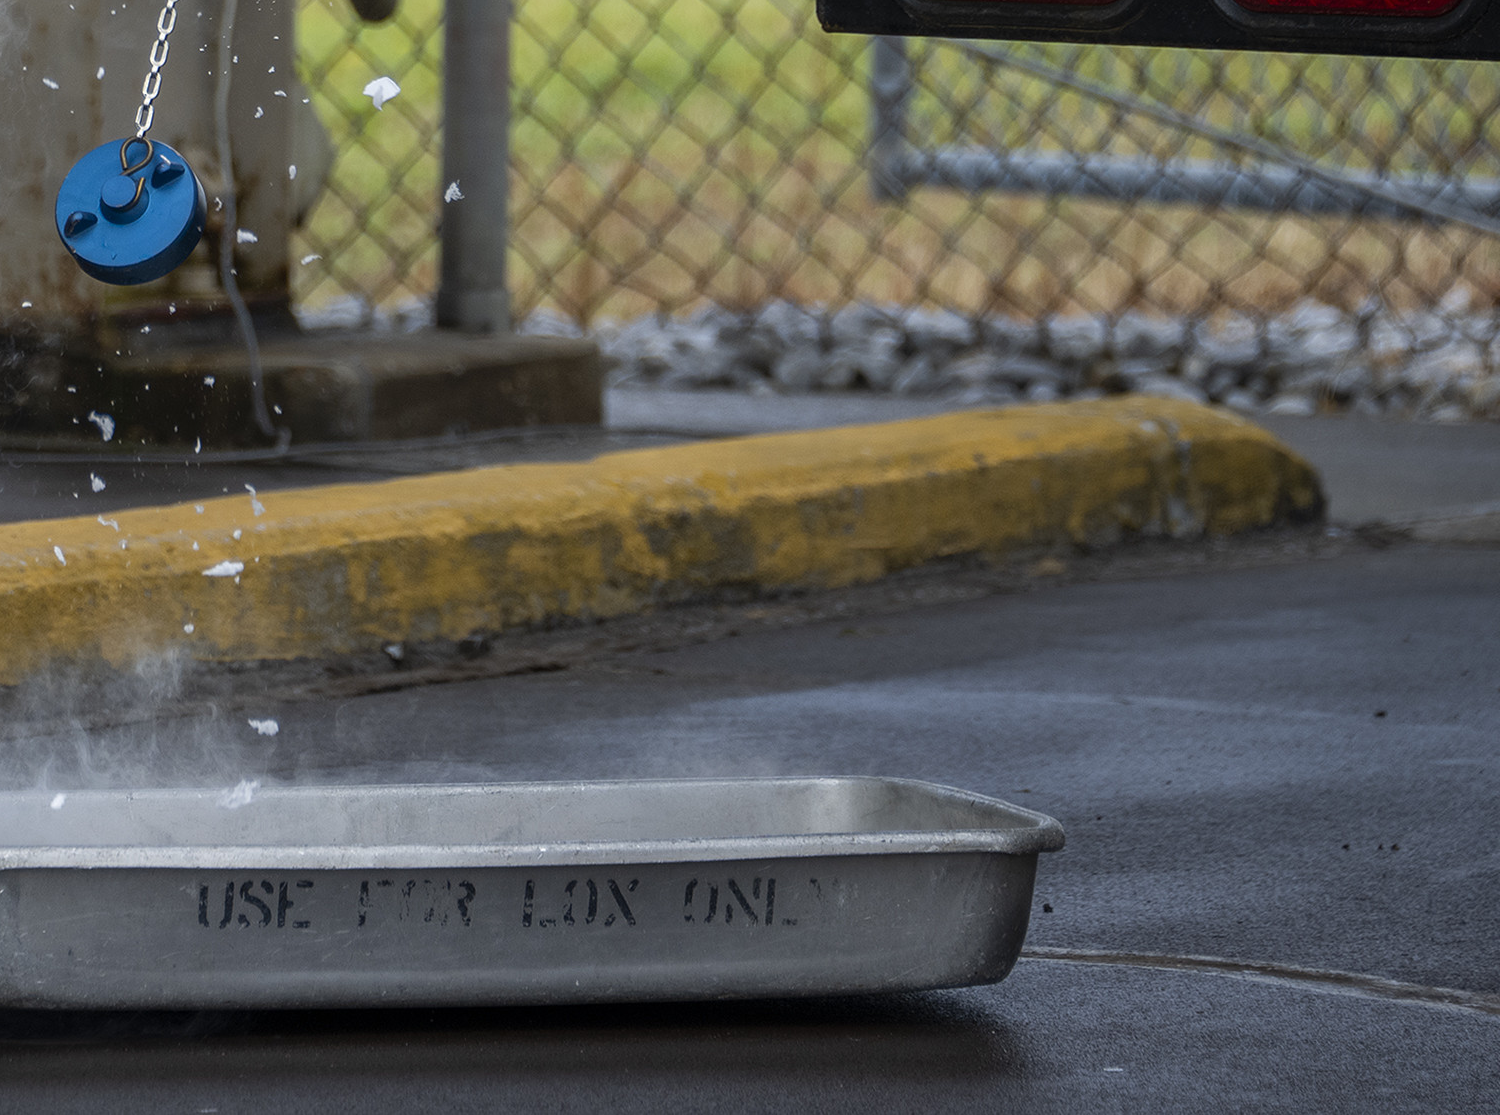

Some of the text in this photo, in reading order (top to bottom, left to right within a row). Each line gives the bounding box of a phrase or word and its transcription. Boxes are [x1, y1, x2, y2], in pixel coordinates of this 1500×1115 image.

[198, 879, 314, 929] USE
[522, 879, 640, 927] LOX
[684, 877, 841, 926] ONL
